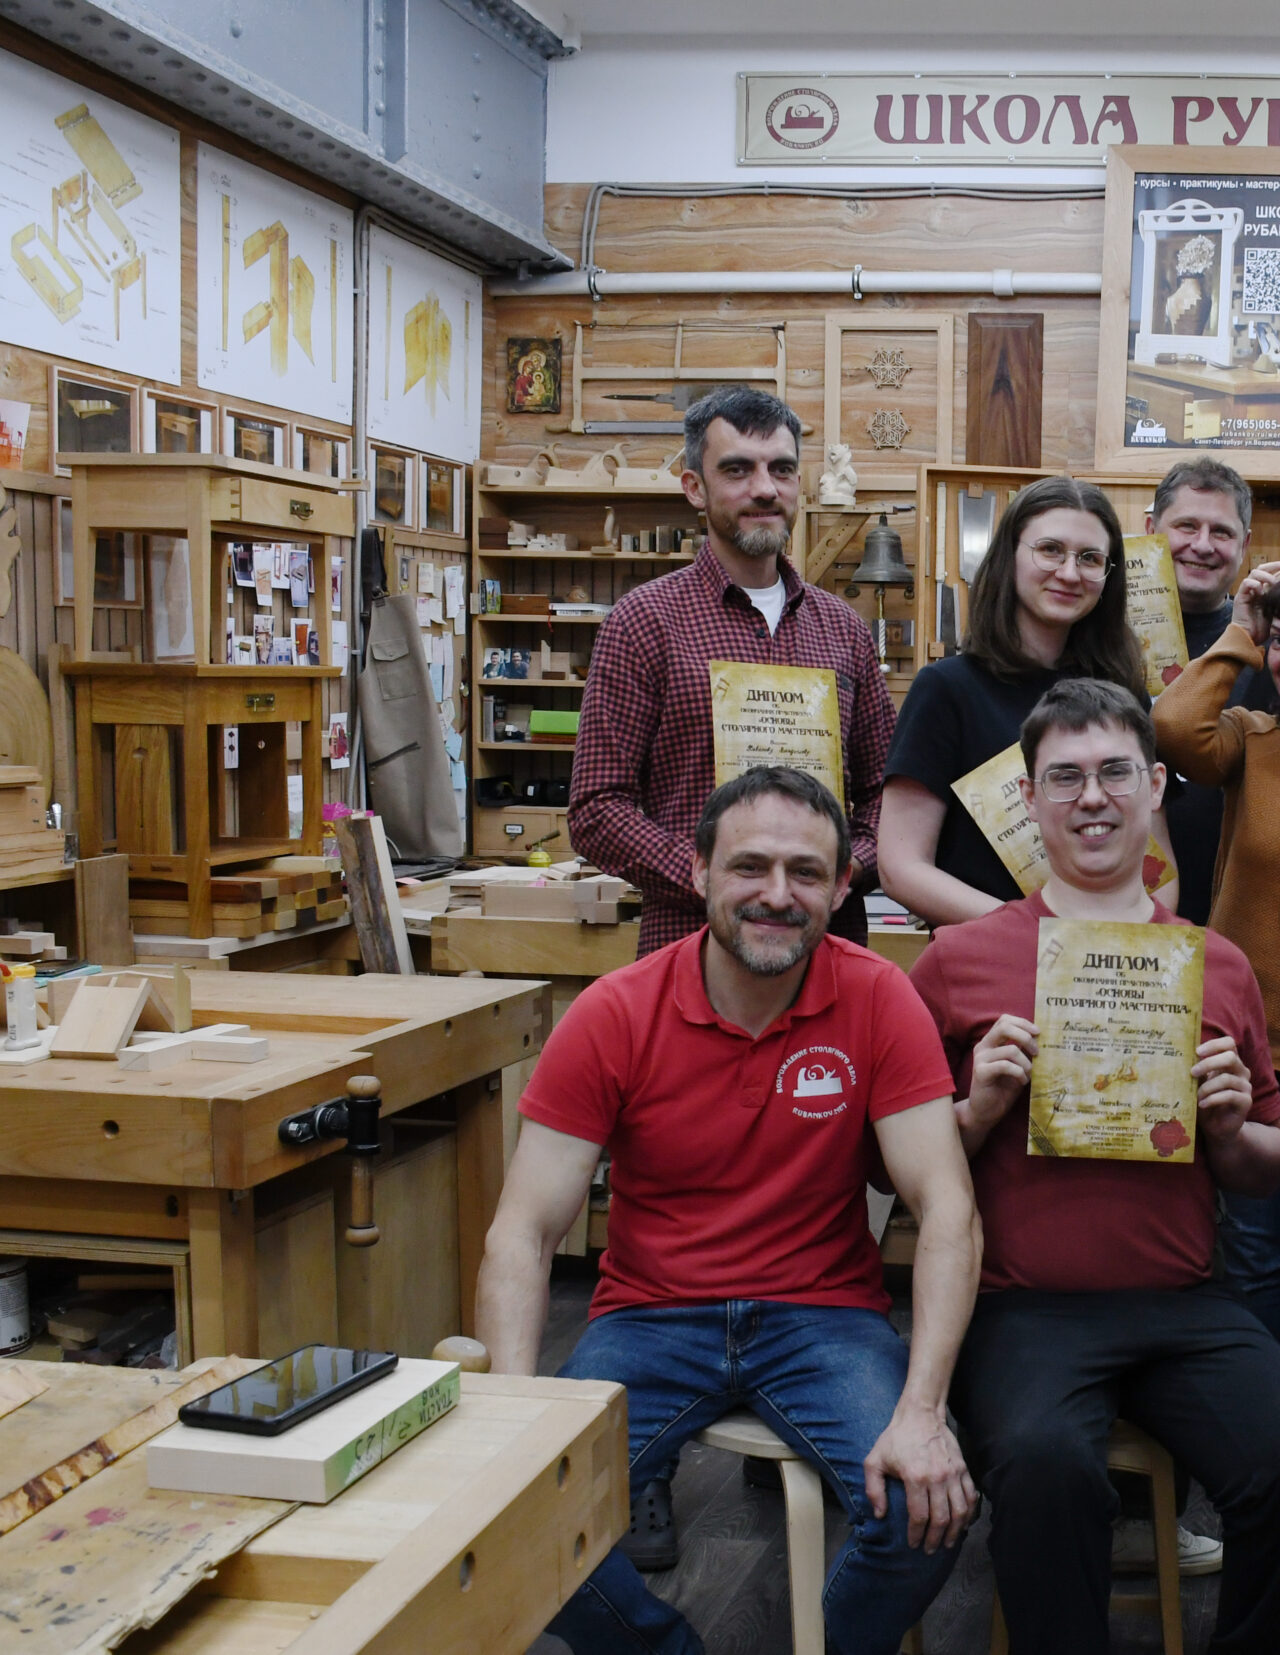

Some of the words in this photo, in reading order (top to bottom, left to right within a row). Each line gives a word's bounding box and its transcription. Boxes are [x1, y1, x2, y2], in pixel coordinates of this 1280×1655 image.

[874, 94, 1138, 144] ШКОЛА
[1140, 179, 1170, 189] курсы
[1180, 179, 1238, 191] практикумы
[746, 689, 804, 704] ДИПЛОМ
[1082, 953, 1159, 972] ДИПЛОМ
[1046, 997, 1116, 1010] СТОЛЯРНОГО
[776, 1048, 808, 1094] ВОЗРОЖДЕНИЕ
[809, 1046, 850, 1065] СТОЛЯРНОГО
[847, 1064, 857, 1086] ДЕЛА
[792, 1101, 848, 1119] RUBANKOV.NET
